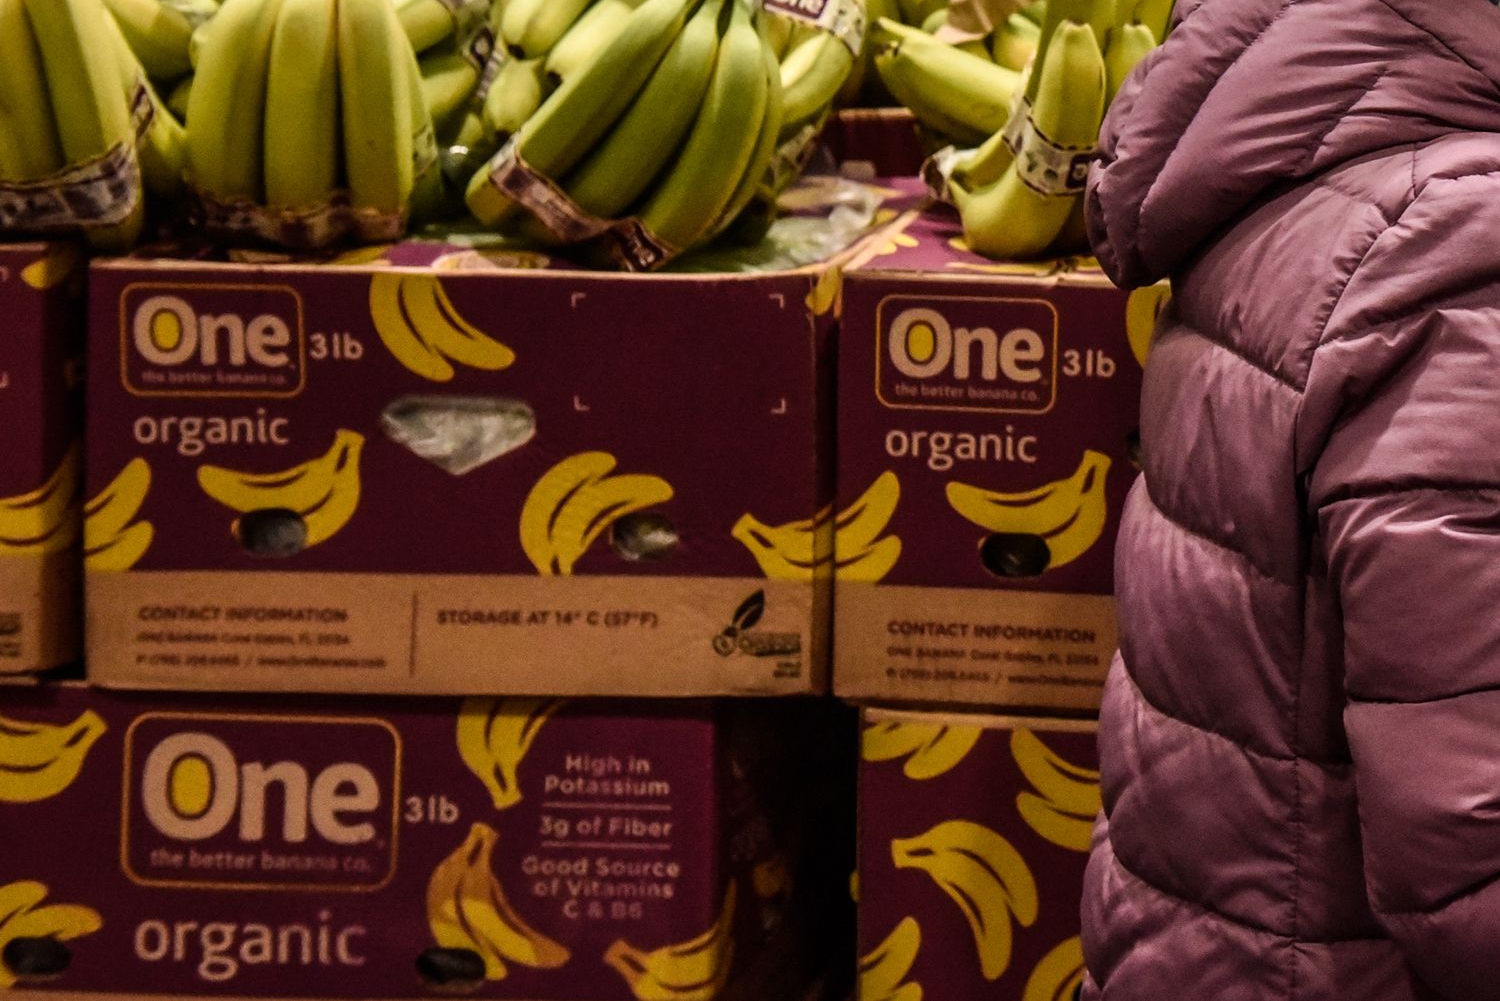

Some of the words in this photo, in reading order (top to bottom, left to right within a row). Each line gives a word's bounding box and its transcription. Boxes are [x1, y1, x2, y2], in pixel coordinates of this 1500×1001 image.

[133, 295, 290, 367] One
[888, 308, 1045, 383] One
[895, 383, 918, 397] the
[920, 383, 965, 398] better
[968, 385, 1017, 400] banana
[1020, 388, 1040, 401] co.
[133, 407, 290, 456] organic
[885, 424, 1038, 471] organic
[138, 605, 219, 621] CONTACT
[225, 606, 348, 623] INFORMATION
[437, 609, 520, 626] STORAGE
[527, 610, 547, 625] AT
[587, 611, 599, 626] C
[887, 620, 968, 638] CONTACT
[973, 623, 1096, 643] INFORMATION
[565, 754, 622, 776] High
[628, 754, 651, 773] in
[142, 731, 380, 845] One
[544, 774, 671, 796] Potassium
[540, 814, 570, 838] 3g
[576, 815, 603, 835] of
[608, 816, 673, 837] Fiber
[150, 849, 183, 868] the
[188, 849, 256, 871] better
[261, 851, 337, 872] banana
[342, 854, 372, 873] co.
[522, 855, 589, 875] Good
[595, 856, 680, 878] Source
[533, 878, 559, 896] of
[567, 879, 675, 899] Vitamins
[563, 899, 579, 919] C
[134, 908, 366, 982] organic
